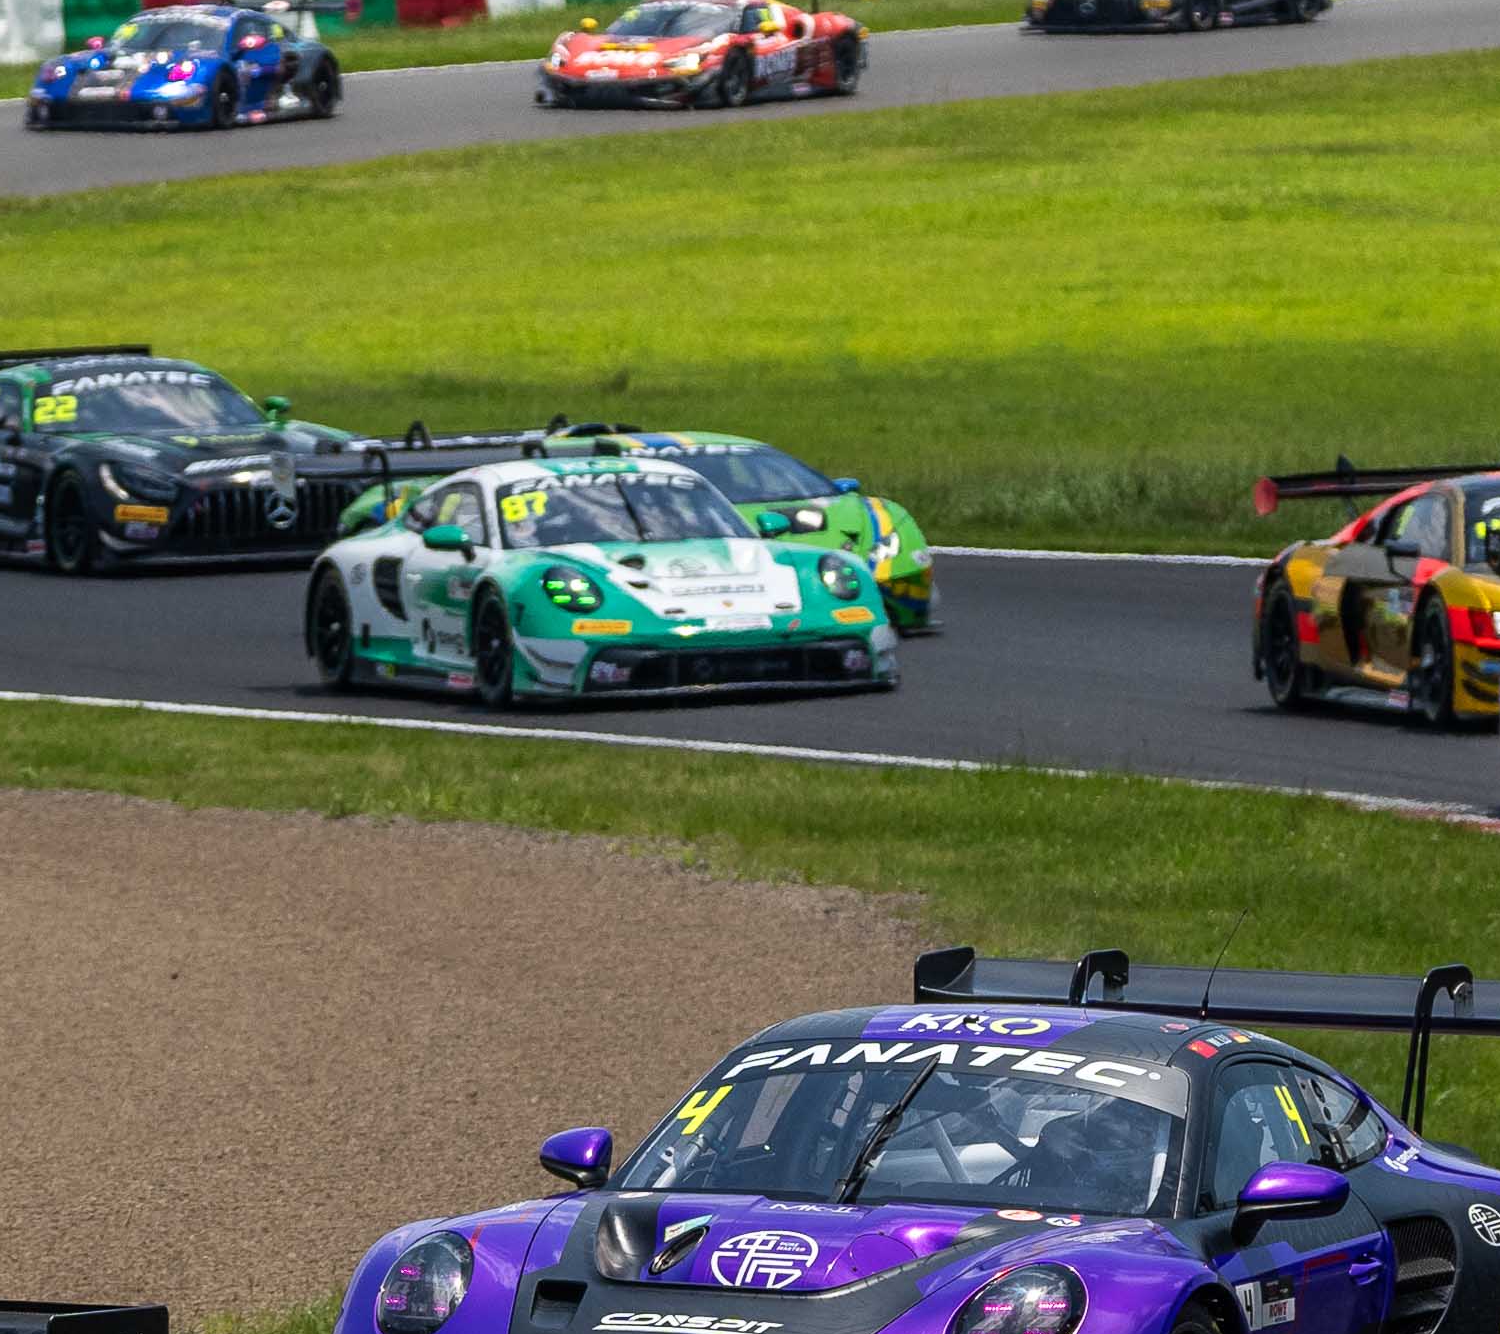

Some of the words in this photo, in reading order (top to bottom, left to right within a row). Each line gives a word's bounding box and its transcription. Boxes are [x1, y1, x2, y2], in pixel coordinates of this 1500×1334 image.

[52, 370, 213, 397] FANATEC
[33, 394, 79, 427] 22
[512, 472, 697, 496] FANATEC
[500, 490, 549, 524] 87
[721, 1042, 1148, 1088] FANATEC
[676, 1085, 734, 1135] 4
[1273, 1085, 1311, 1146] 4
